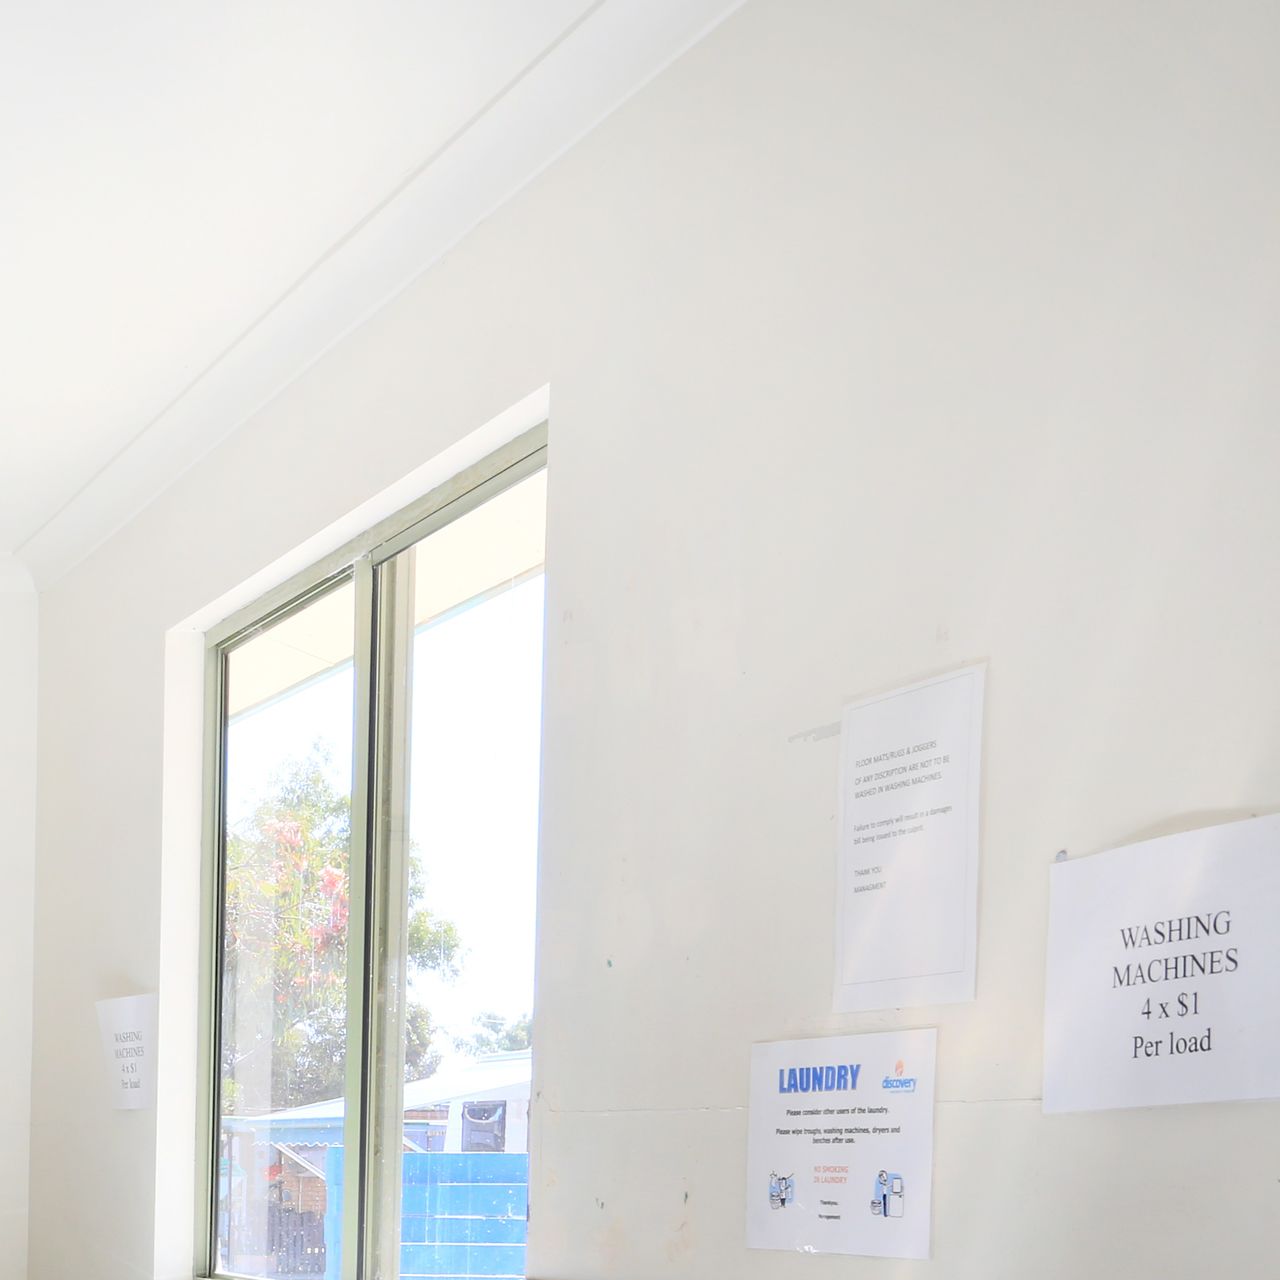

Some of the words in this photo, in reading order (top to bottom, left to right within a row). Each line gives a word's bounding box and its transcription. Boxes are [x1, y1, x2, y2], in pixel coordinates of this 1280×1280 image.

[855, 757, 873, 768] FLOOR
[862, 774, 873, 783] ANY
[908, 762, 919, 772] ARE
[920, 758, 932, 768] NOT
[942, 754, 950, 764] BE
[854, 787, 877, 799] WASHED
[885, 778, 910, 792] WASHING
[1120, 910, 1232, 950] WASHING
[1112, 948, 1239, 988] MACHINES
[1141, 997, 1152, 1020] 4
[1158, 1002, 1170, 1019] x
[1176, 991, 1200, 1018] $1
[1132, 1035, 1163, 1059] Per
[1169, 1027, 1212, 1055] load
[114, 1046, 145, 1059] MACHINES
[778, 1064, 862, 1094] LAUNDRY
[882, 1076, 918, 1092] discovery
[802, 1108, 822, 1116] consider
[823, 1108, 836, 1116] other
[776, 1128, 791, 1136] Please
[792, 1128, 803, 1136] wipe
[823, 1127, 843, 1136] washing
[872, 1126, 890, 1135] dryers
[812, 1136, 831, 1144] benches
[832, 1136, 843, 1144] after
[822, 1166, 849, 1174] SMOKING
[821, 1176, 848, 1184] LAUNDRY
